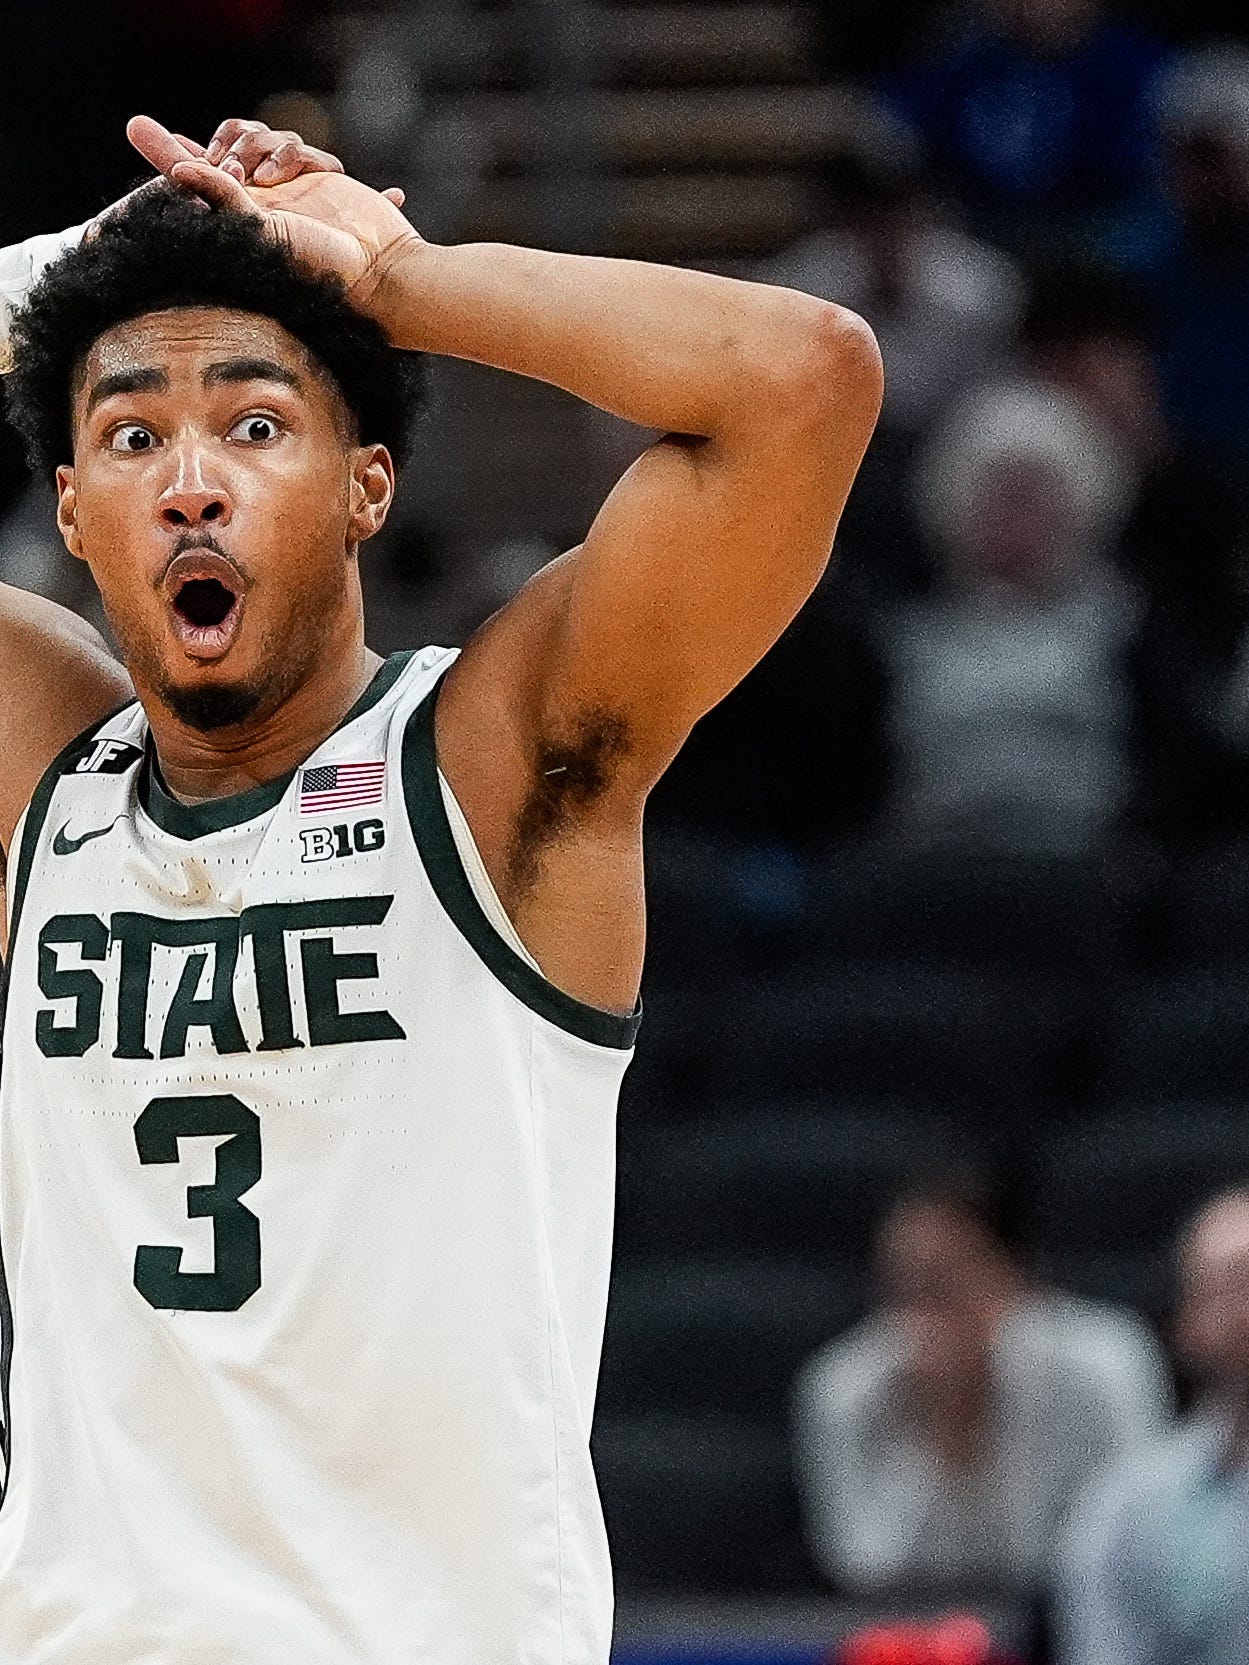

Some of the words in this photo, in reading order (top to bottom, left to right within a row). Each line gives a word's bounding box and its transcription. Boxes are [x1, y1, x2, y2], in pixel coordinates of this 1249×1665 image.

[76, 740, 129, 772] JF
[36, 895, 407, 1060] STATE
[133, 1094, 261, 1312] 3
